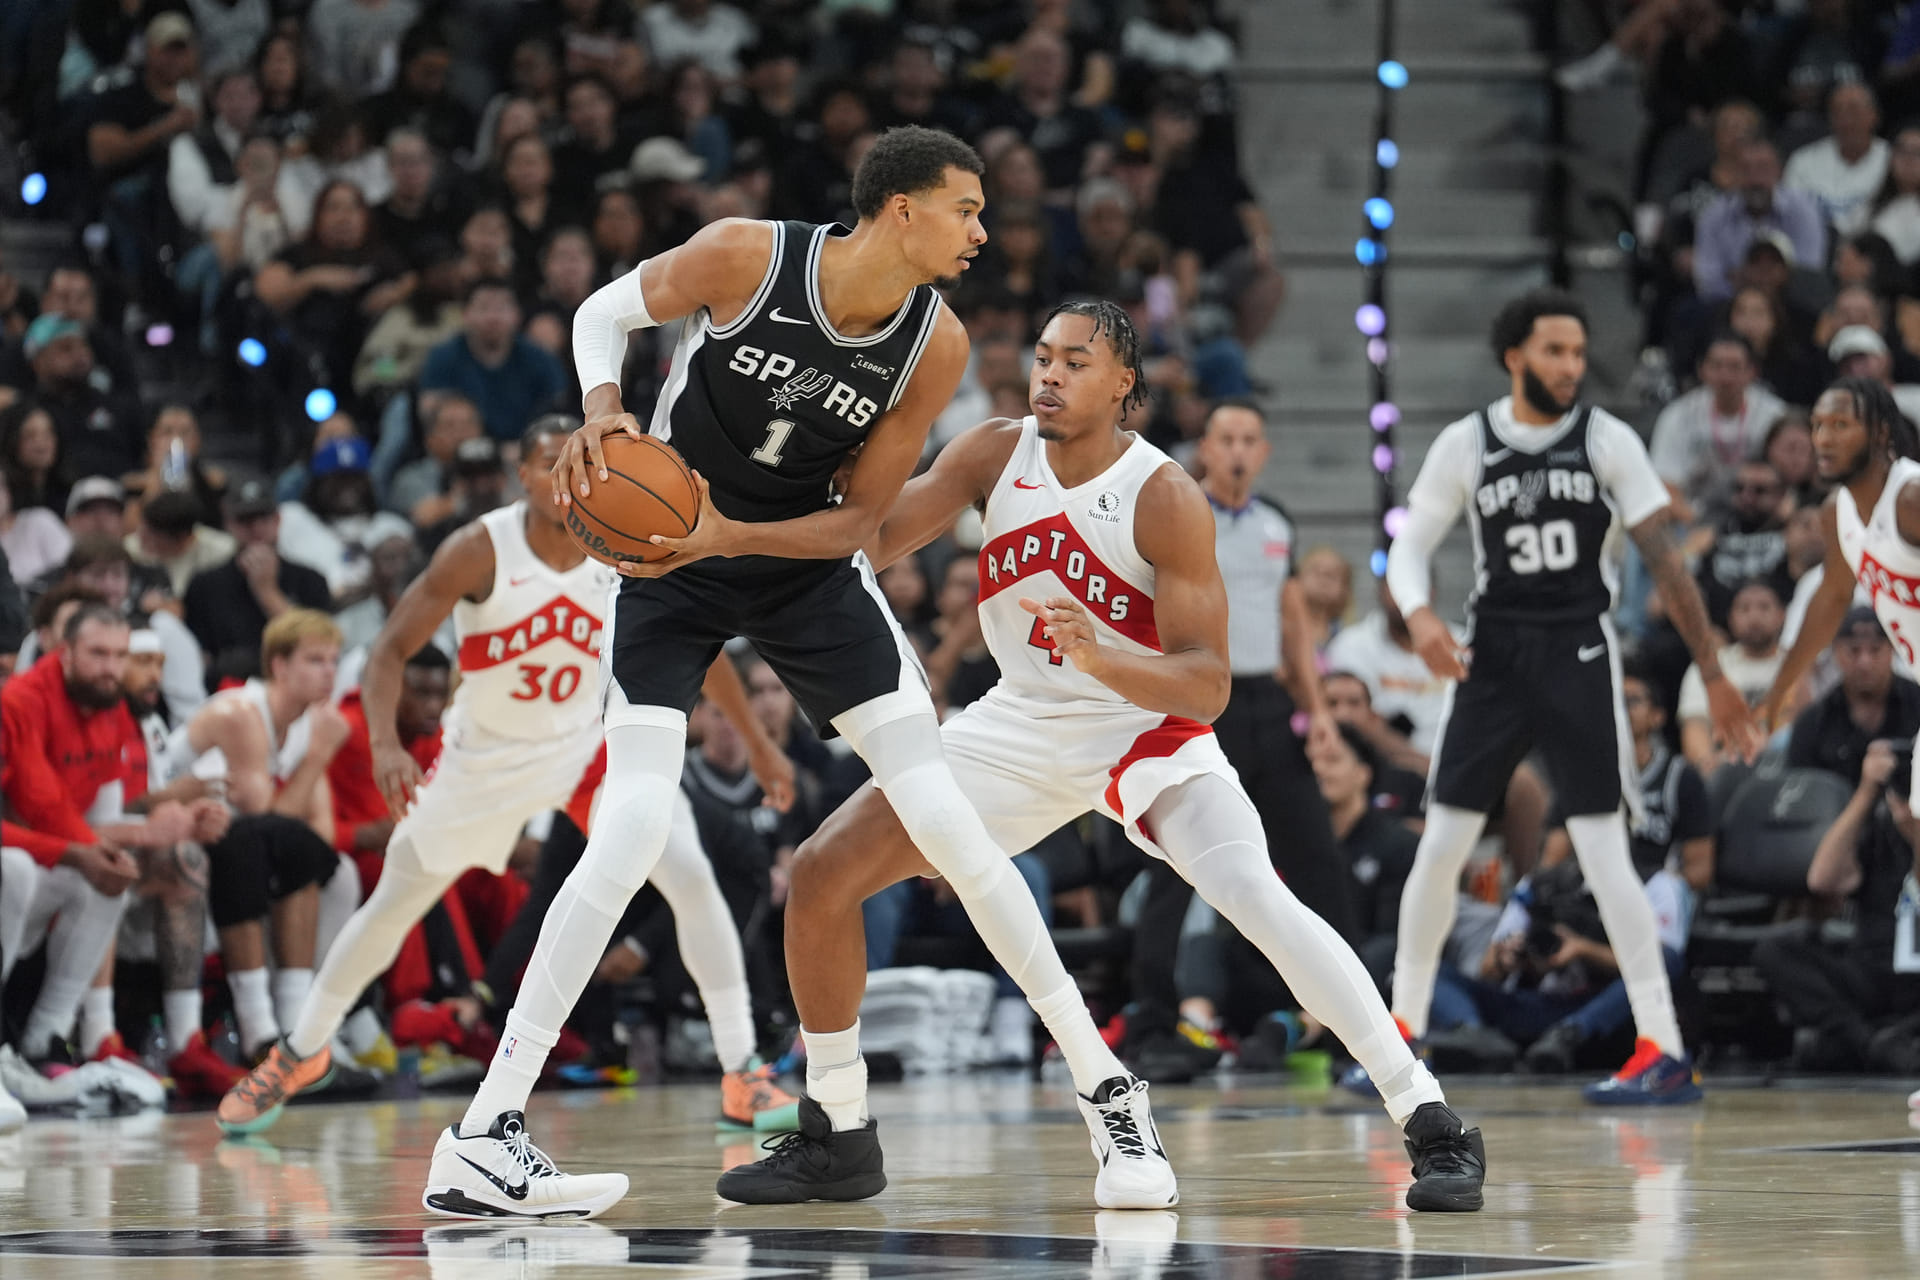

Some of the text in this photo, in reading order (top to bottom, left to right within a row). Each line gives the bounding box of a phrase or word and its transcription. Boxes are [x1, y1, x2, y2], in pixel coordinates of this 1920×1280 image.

[857, 359, 888, 376] LEDGER
[749, 418, 795, 468] 1
[566, 506, 645, 562] Wilson
[1087, 508, 1121, 524] Sun Life
[1505, 519, 1578, 575] 30
[988, 529, 1130, 621] RAPTORS
[509, 662, 582, 703] 30
